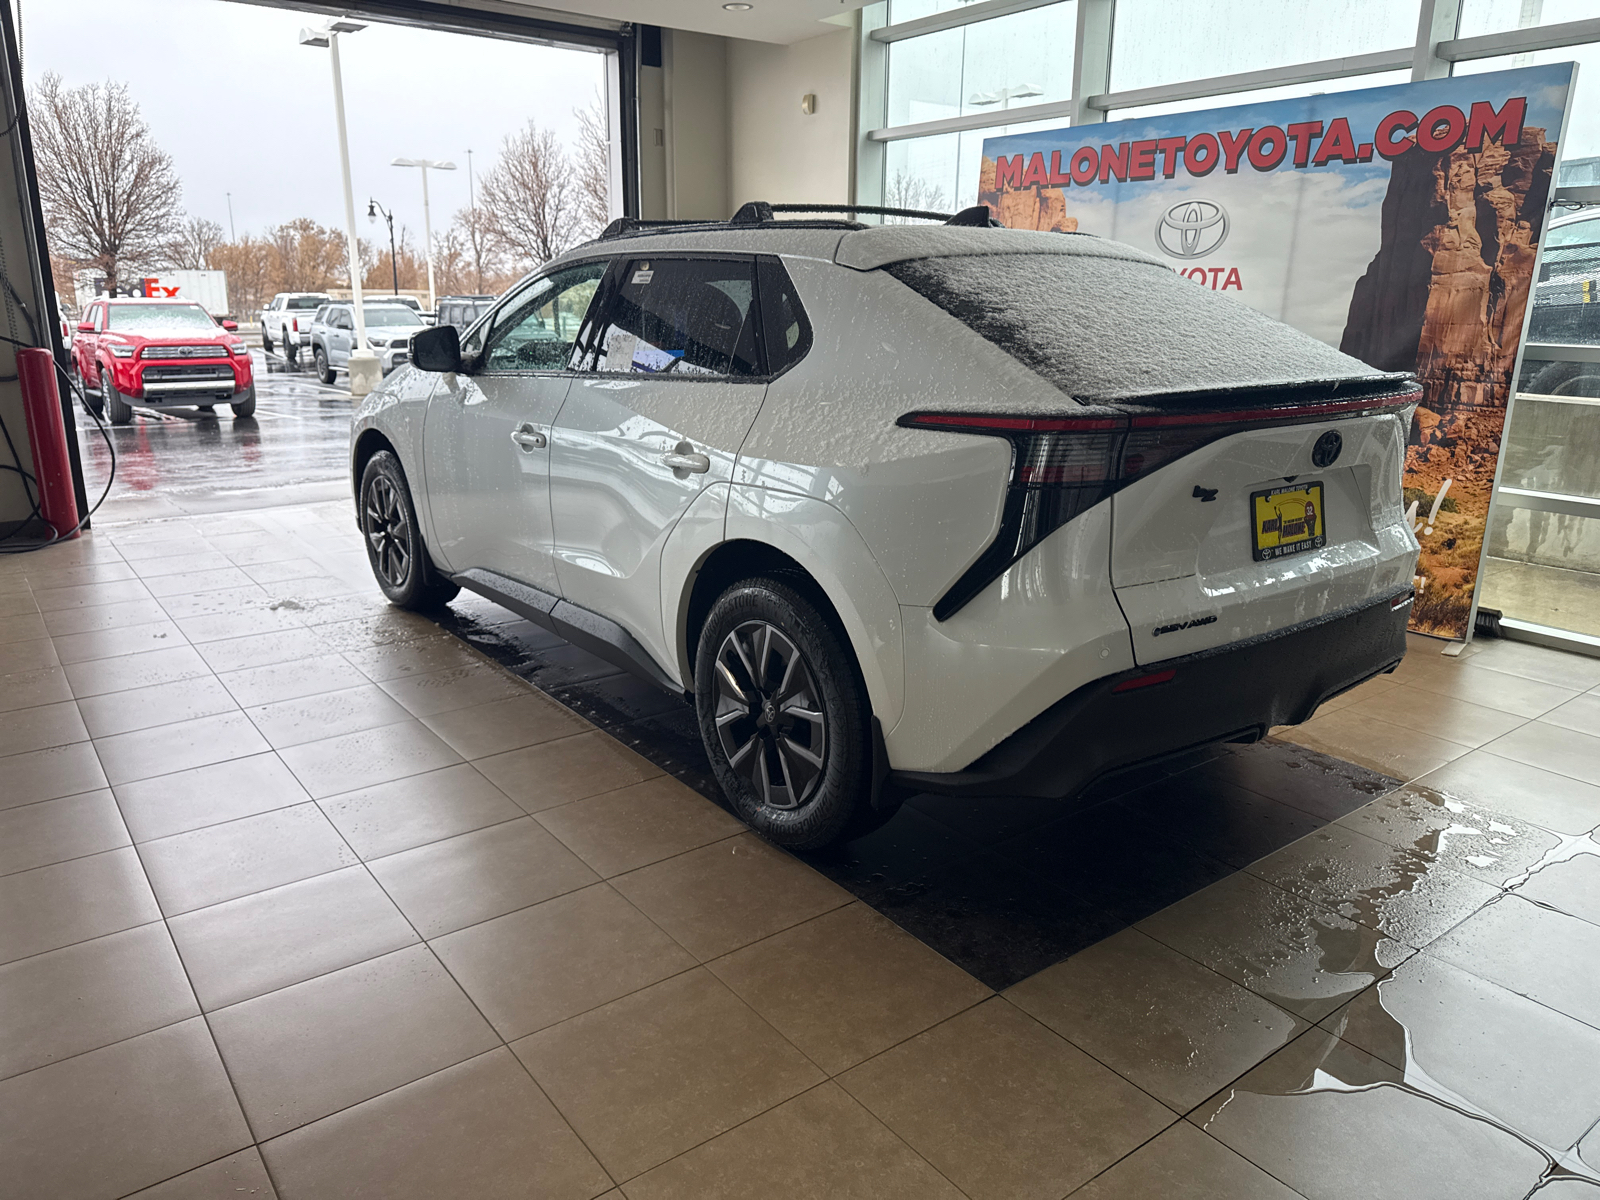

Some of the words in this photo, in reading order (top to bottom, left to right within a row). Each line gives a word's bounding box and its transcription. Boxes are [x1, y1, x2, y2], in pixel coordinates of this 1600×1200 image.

[995, 96, 1527, 191] MALONETOYOTA.COM
[1307, 506, 1313, 515] 32
[1275, 548, 1282, 556] WE
[1283, 545, 1296, 554] MAKE
[1302, 540, 1312, 550] EASY
